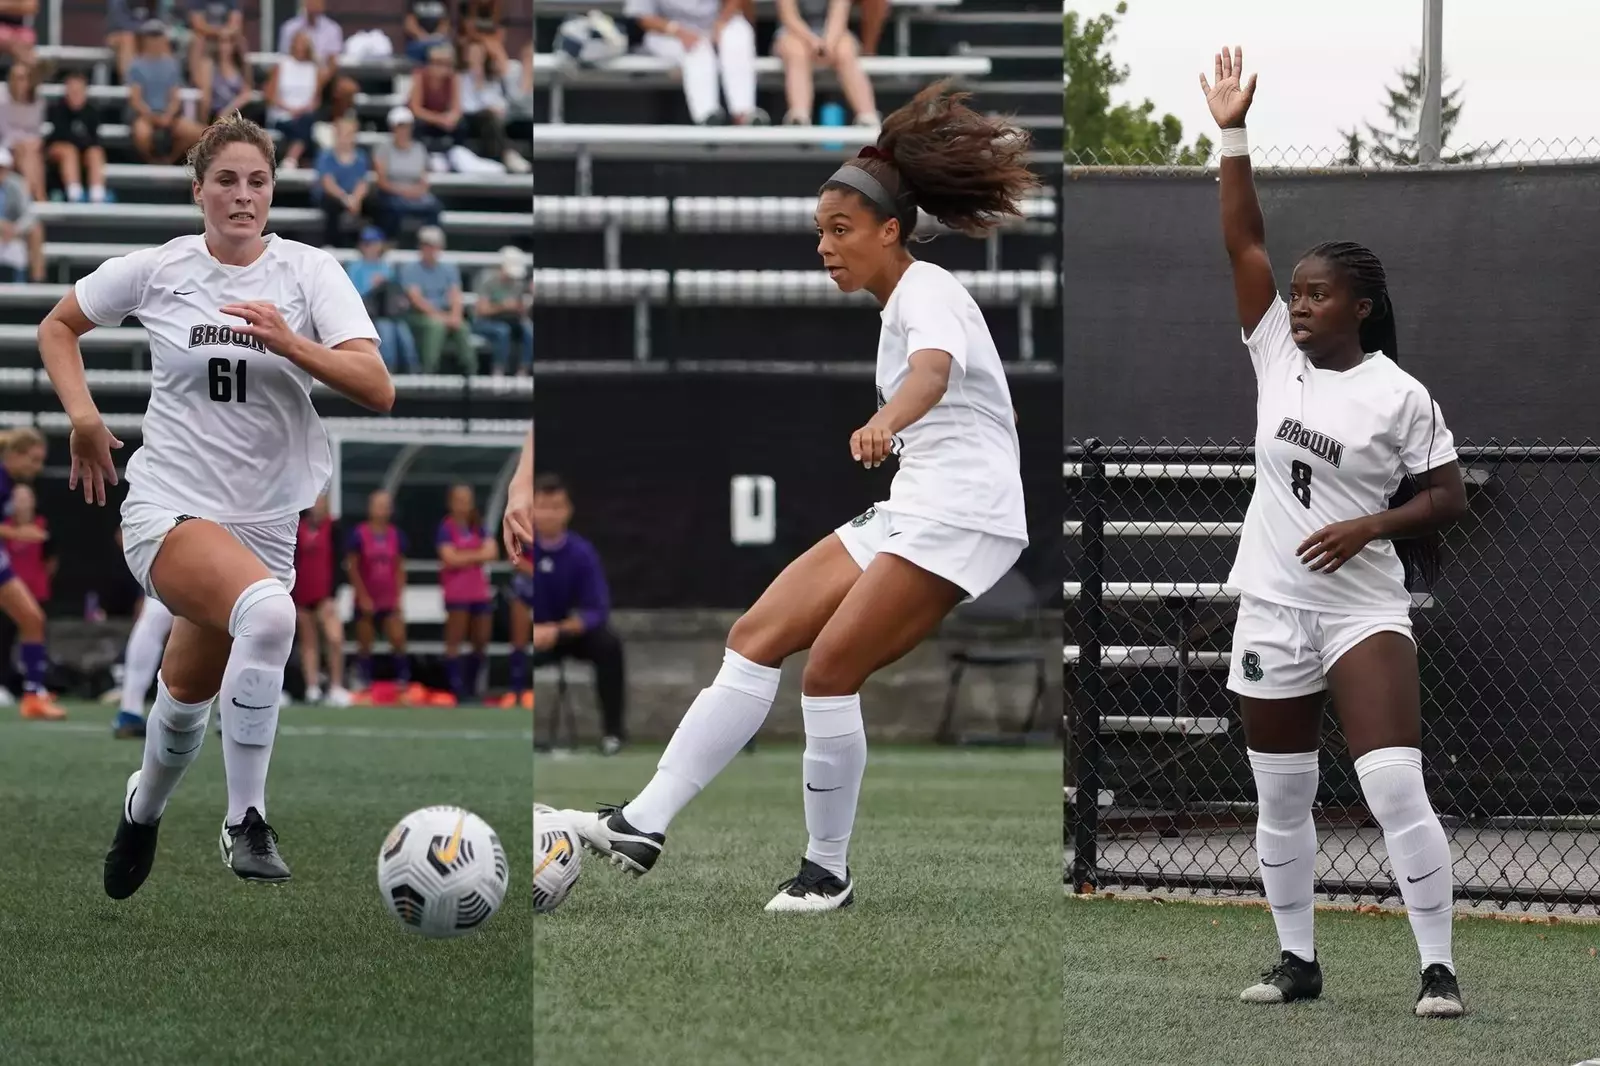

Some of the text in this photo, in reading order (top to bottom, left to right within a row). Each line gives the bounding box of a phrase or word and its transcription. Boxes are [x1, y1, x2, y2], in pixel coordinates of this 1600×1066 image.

[208, 357, 247, 403] 61
[1274, 416, 1345, 469] BROWN
[1291, 459, 1312, 509] 8
[1241, 649, 1264, 682] B
